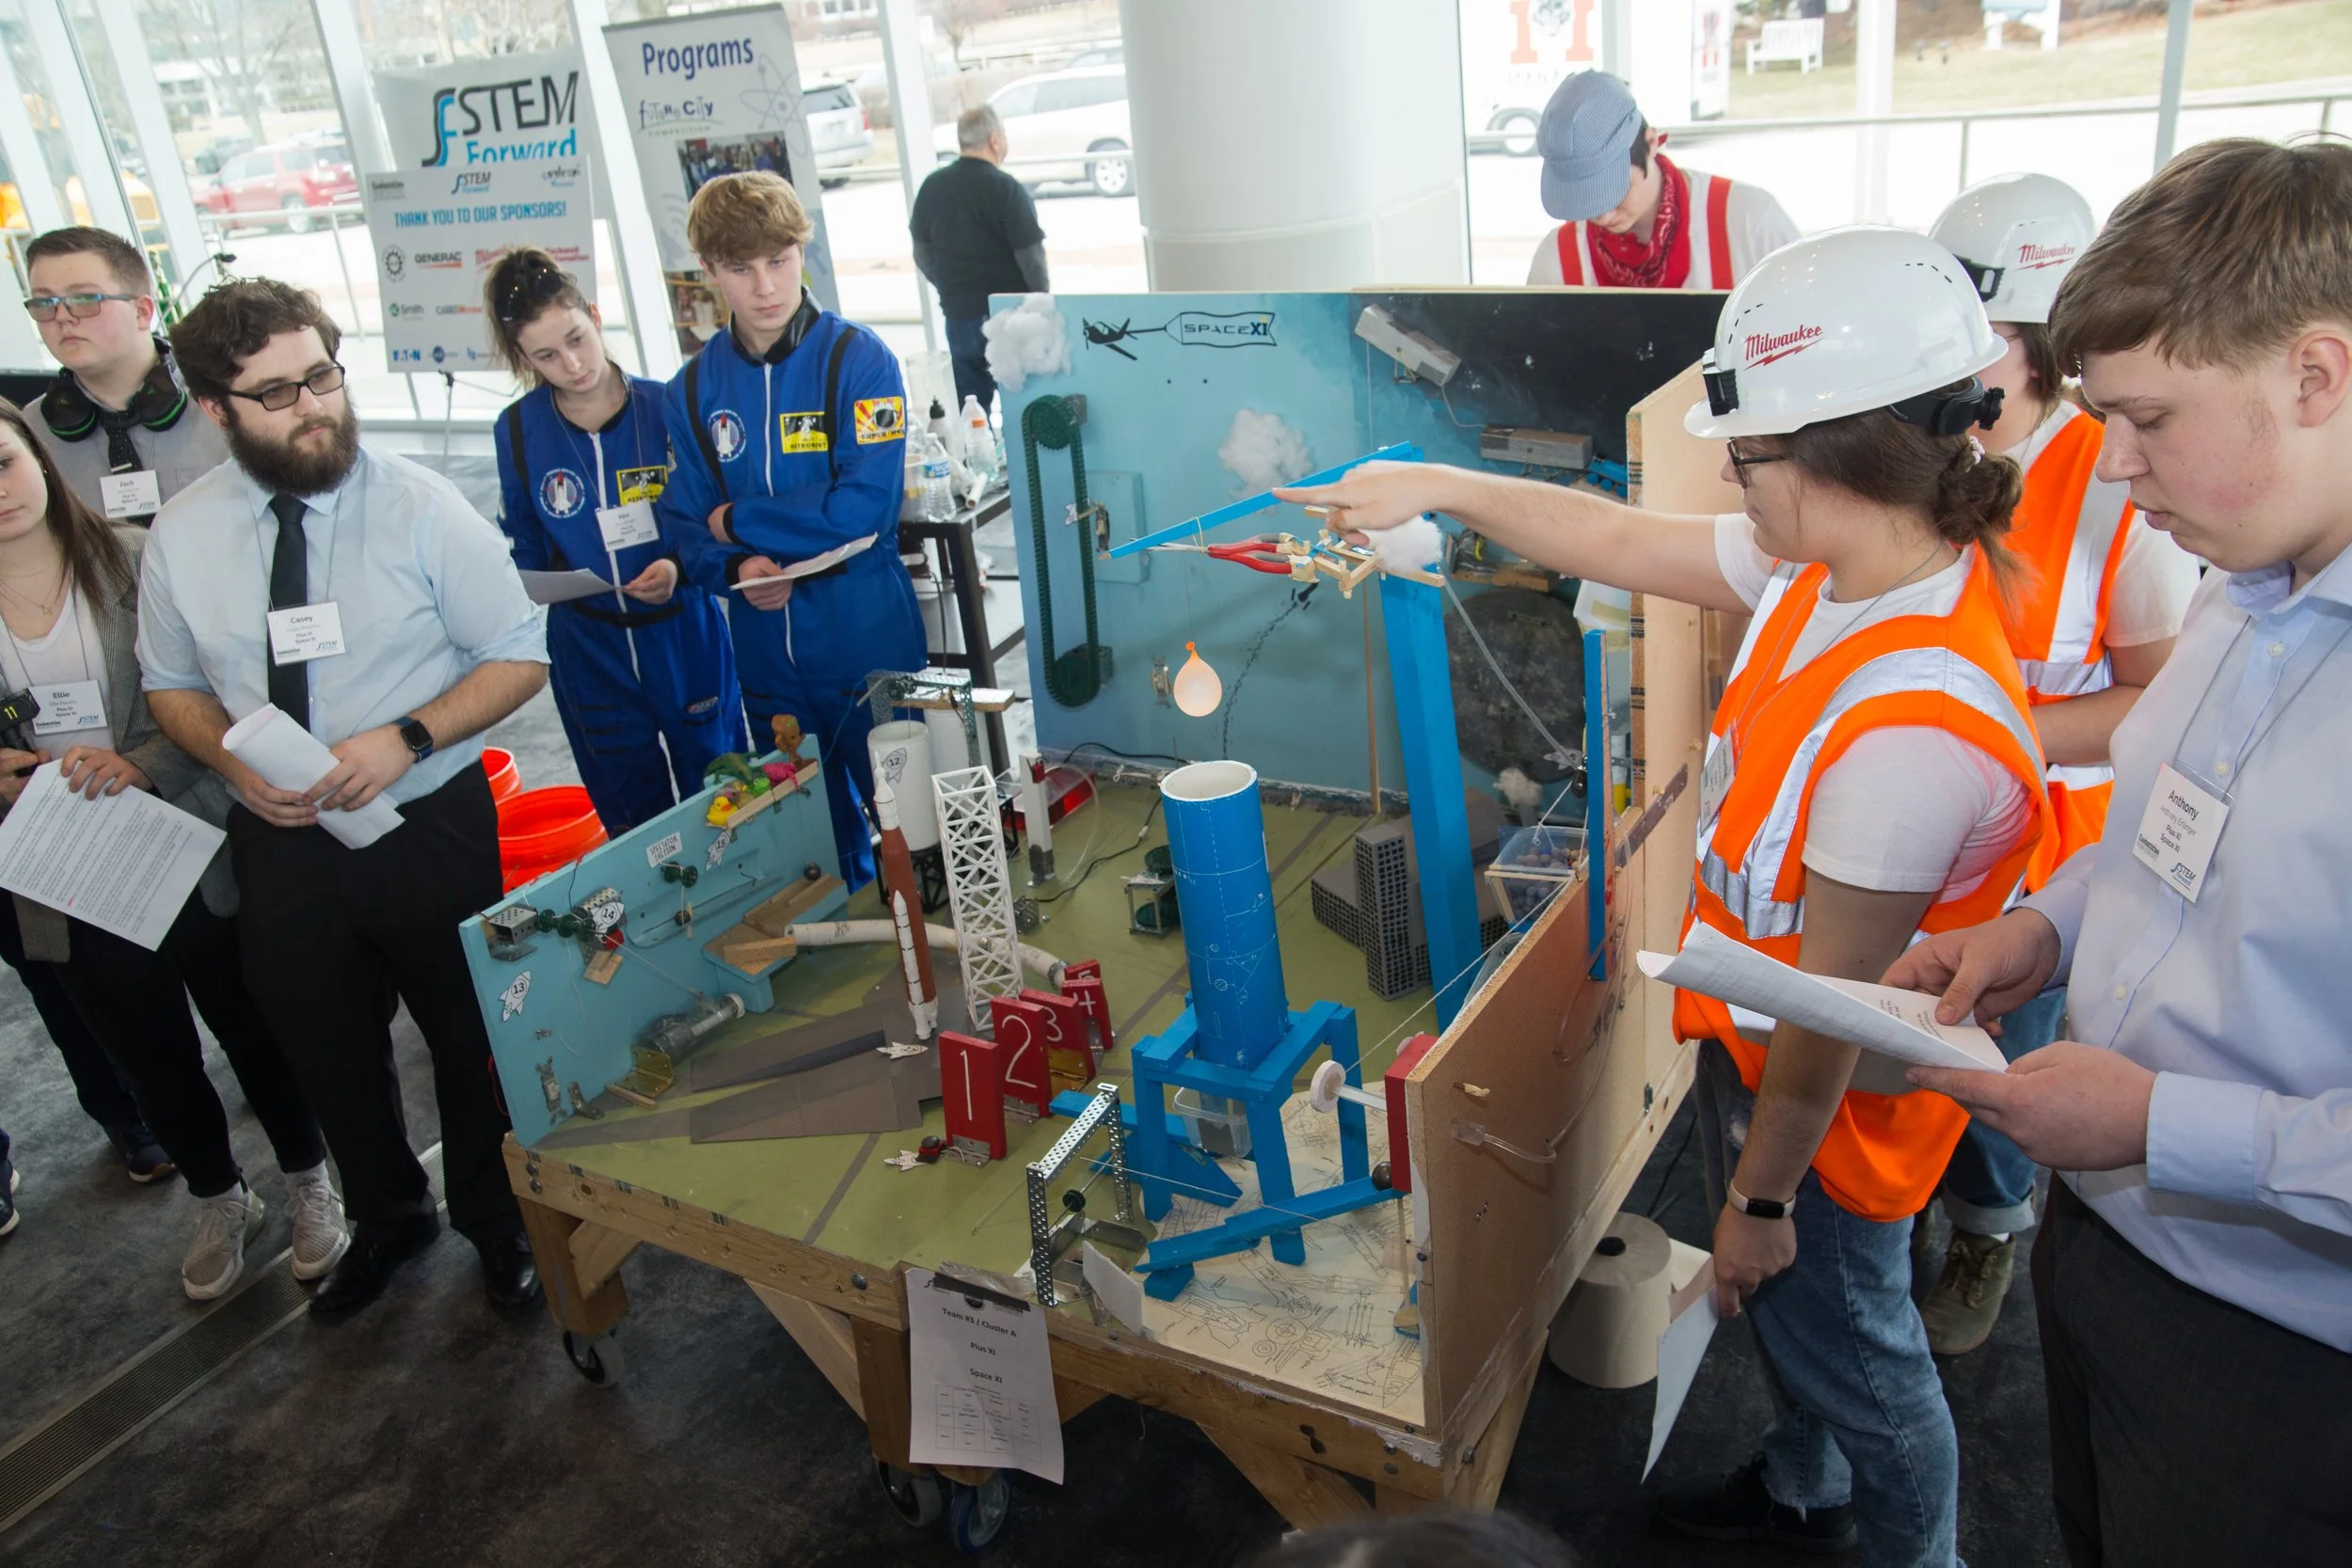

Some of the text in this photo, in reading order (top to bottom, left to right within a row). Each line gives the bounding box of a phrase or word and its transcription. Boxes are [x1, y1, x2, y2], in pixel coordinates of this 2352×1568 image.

[642, 38, 754, 81] Programs
[458, 71, 580, 136] STEM
[394, 200, 567, 228] THANK YOU TO OUR SPONSORS!
[415, 251, 463, 264] GENERAC
[2017, 243, 2075, 263] Milwaukee
[401, 304, 424, 314] Smith
[1742, 325, 1823, 361] Milwaukee
[290, 616, 313, 625] Casey
[4, 705, 19, 721] 11
[889, 756, 901, 767] 12
[2168, 790, 2200, 821] Anthony
[602, 909, 614, 920] 14
[513, 982, 525, 995] 13
[1073, 990, 1096, 1015] 4
[1044, 1006, 1063, 1041] 3
[1002, 1014, 1038, 1088] 2
[960, 1050, 973, 1121] 1
[942, 1307, 964, 1322] Team
[981, 1320, 1009, 1336] Cluster
[1010, 1328, 1017, 1338] A
[970, 1341, 996, 1356] Pius XI
[969, 1368, 1003, 1384] Space XI
